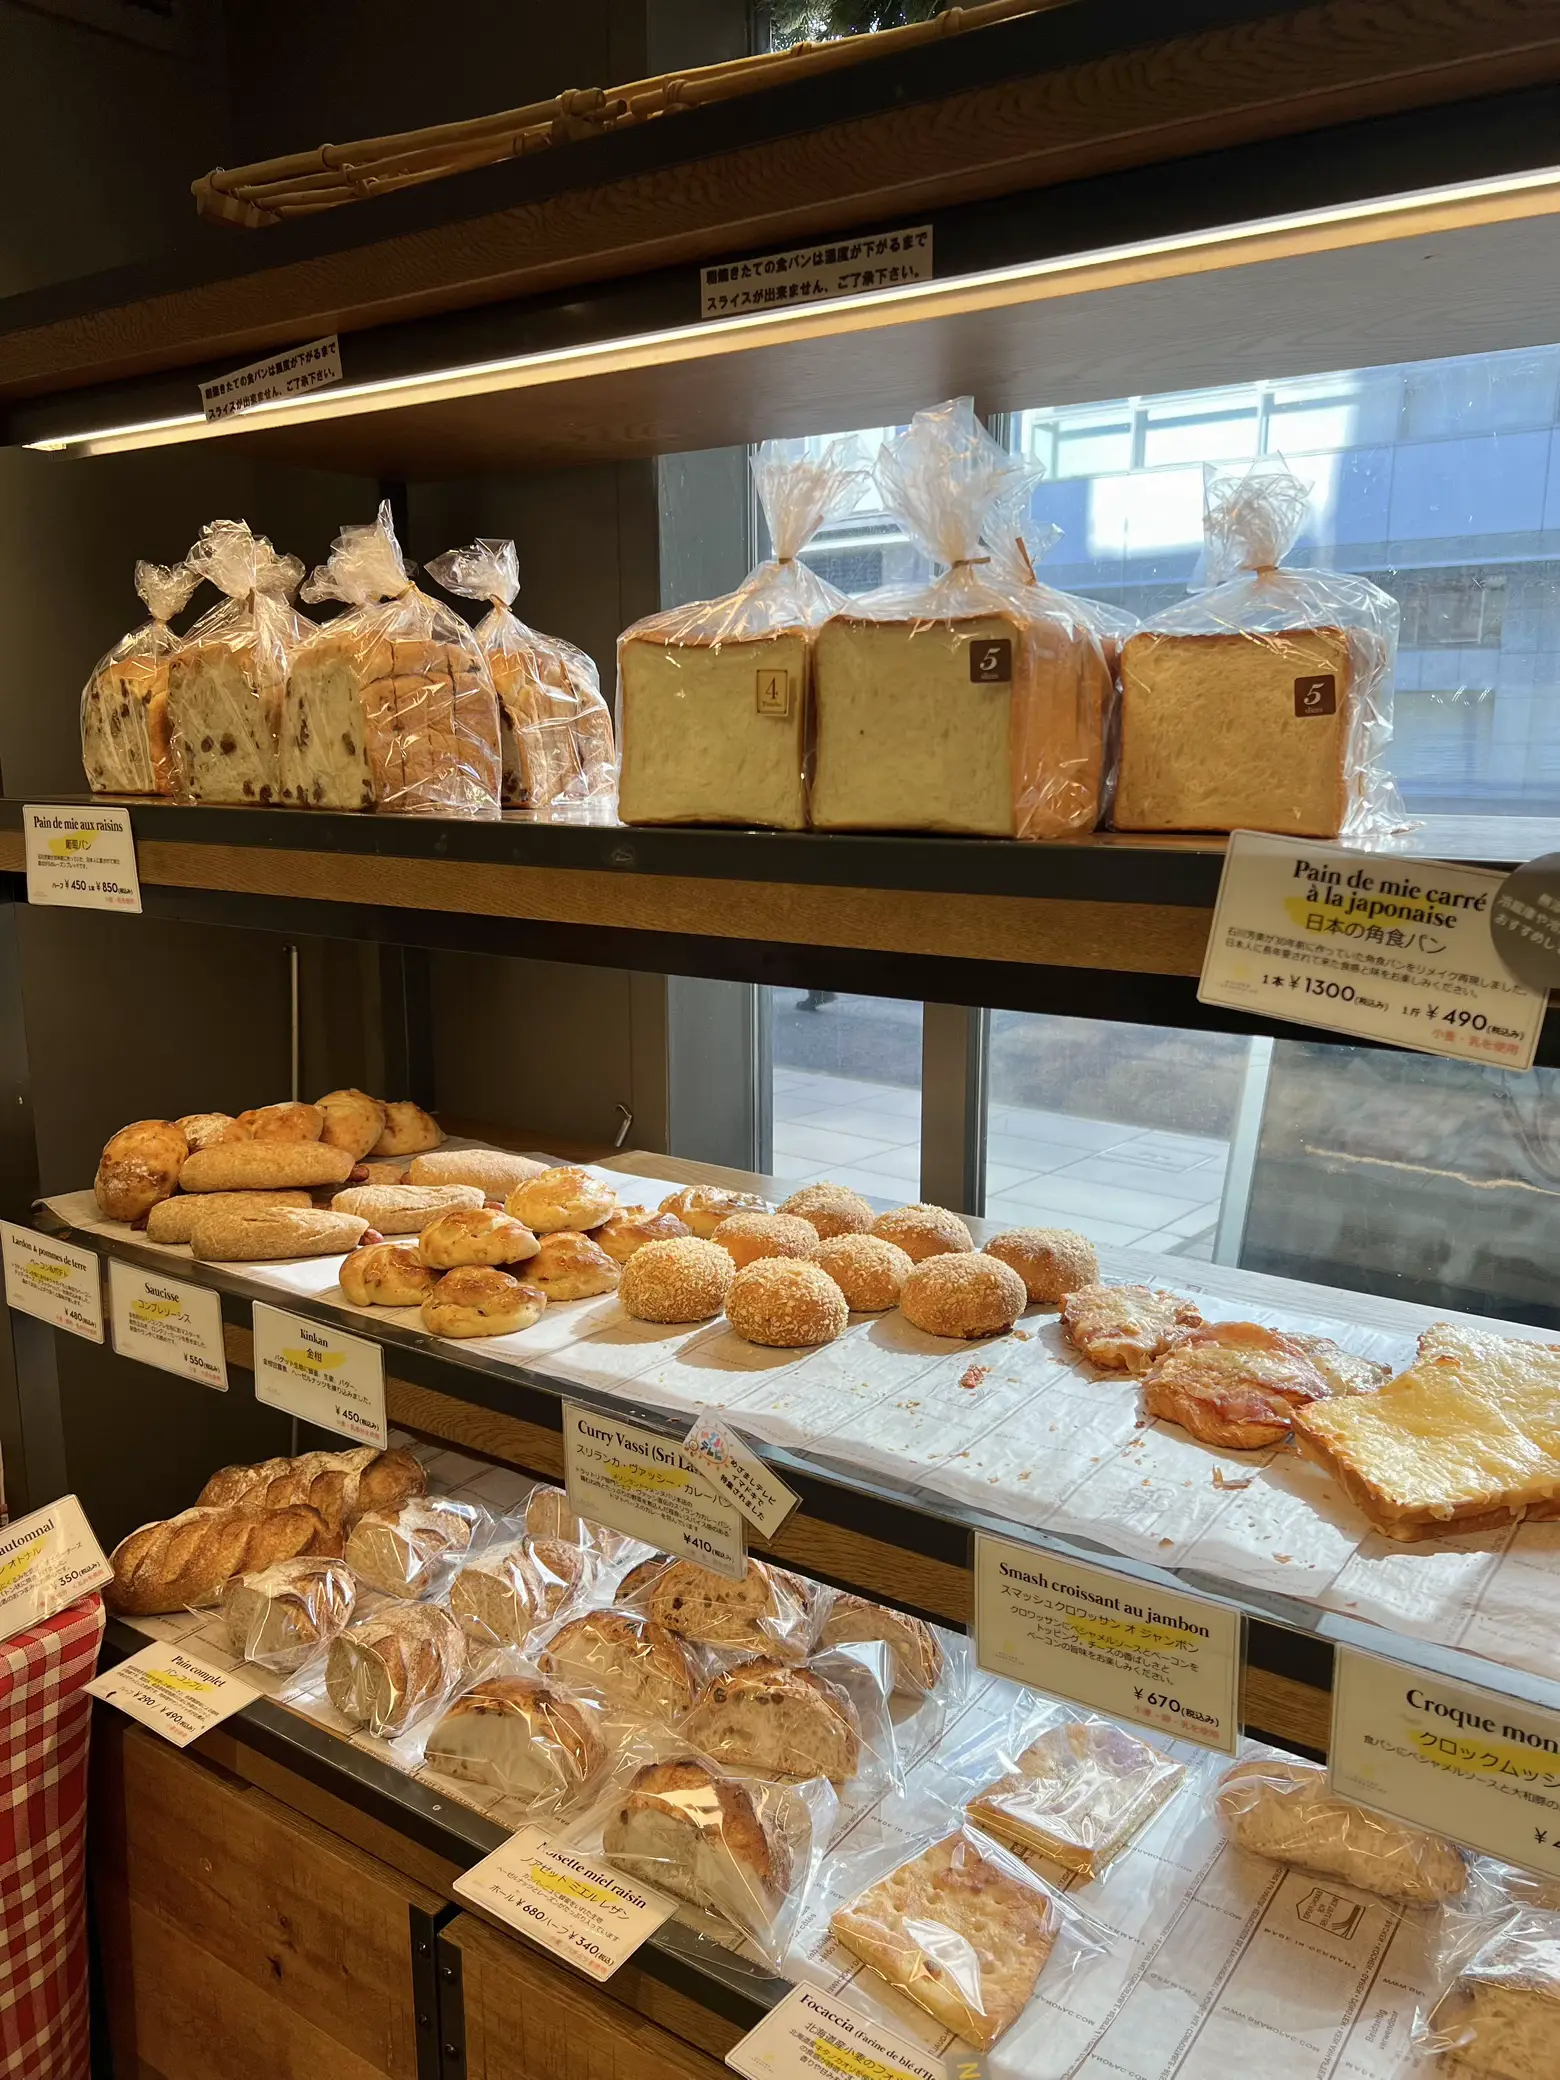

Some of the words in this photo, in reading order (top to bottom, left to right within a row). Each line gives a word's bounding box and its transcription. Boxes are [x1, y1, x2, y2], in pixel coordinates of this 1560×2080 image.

[980, 647, 1001, 671] 5
[765, 676, 779, 699] 4
[1303, 682, 1325, 705] 5
[33, 816, 51, 828] Pain
[52, 816, 62, 828] de
[63, 817, 78, 829] mie
[80, 821, 94, 830] aux
[95, 819, 123, 831] raisins
[1292, 859, 1343, 885] Pain
[1346, 868, 1376, 891] de
[1378, 876, 1422, 899] mie
[1425, 883, 1487, 912] carré
[1305, 882, 1320, 903] à
[1323, 885, 1346, 907] la
[1344, 892, 1459, 934] japonaise
[1305, 912, 1447, 956] 日本の角食パン
[1495, 914, 1560, 954] おすすめし
[144, 1281, 179, 1303] Saucisse
[300, 1328, 327, 1347] Kinkan
[306, 1347, 322, 1363] 金柑
[577, 1418, 613, 1448] Curry
[616, 1432, 648, 1456] Vassi
[651, 1444, 674, 1468] (Sri
[719, 1472, 765, 1523] 特集されました
[729, 1456, 776, 1507] めざましテレビ
[731, 1471, 764, 1507] イマドキで
[0, 1519, 55, 1556] automnal
[684, 1532, 711, 1554] ¥410
[999, 1561, 1048, 1588] Smash
[1051, 1576, 1119, 1611] croissant
[1123, 1601, 1142, 1618] au
[1145, 1605, 1209, 1642] jambon
[1001, 1583, 1120, 1630] スマッシュクロワッサン
[1125, 1621, 1134, 1634] オ
[1140, 1626, 1198, 1655] ジャンボン
[170, 1655, 195, 1669] Pain
[186, 1665, 228, 1688] complet
[1180, 1705, 1219, 1728] (税込み)
[1406, 1689, 1496, 1733] Croque
[519, 1853, 569, 1884] ノアゼット
[567, 1881, 600, 1903] ミエル
[598, 1899, 632, 1921] レザン
[582, 1867, 614, 1888] miel
[610, 1882, 650, 1908] raisin
[798, 1993, 857, 2032] Focaccia
[853, 2029, 888, 2053] (Farine
[884, 2048, 900, 2060] de
[897, 2056, 916, 2070] blé
